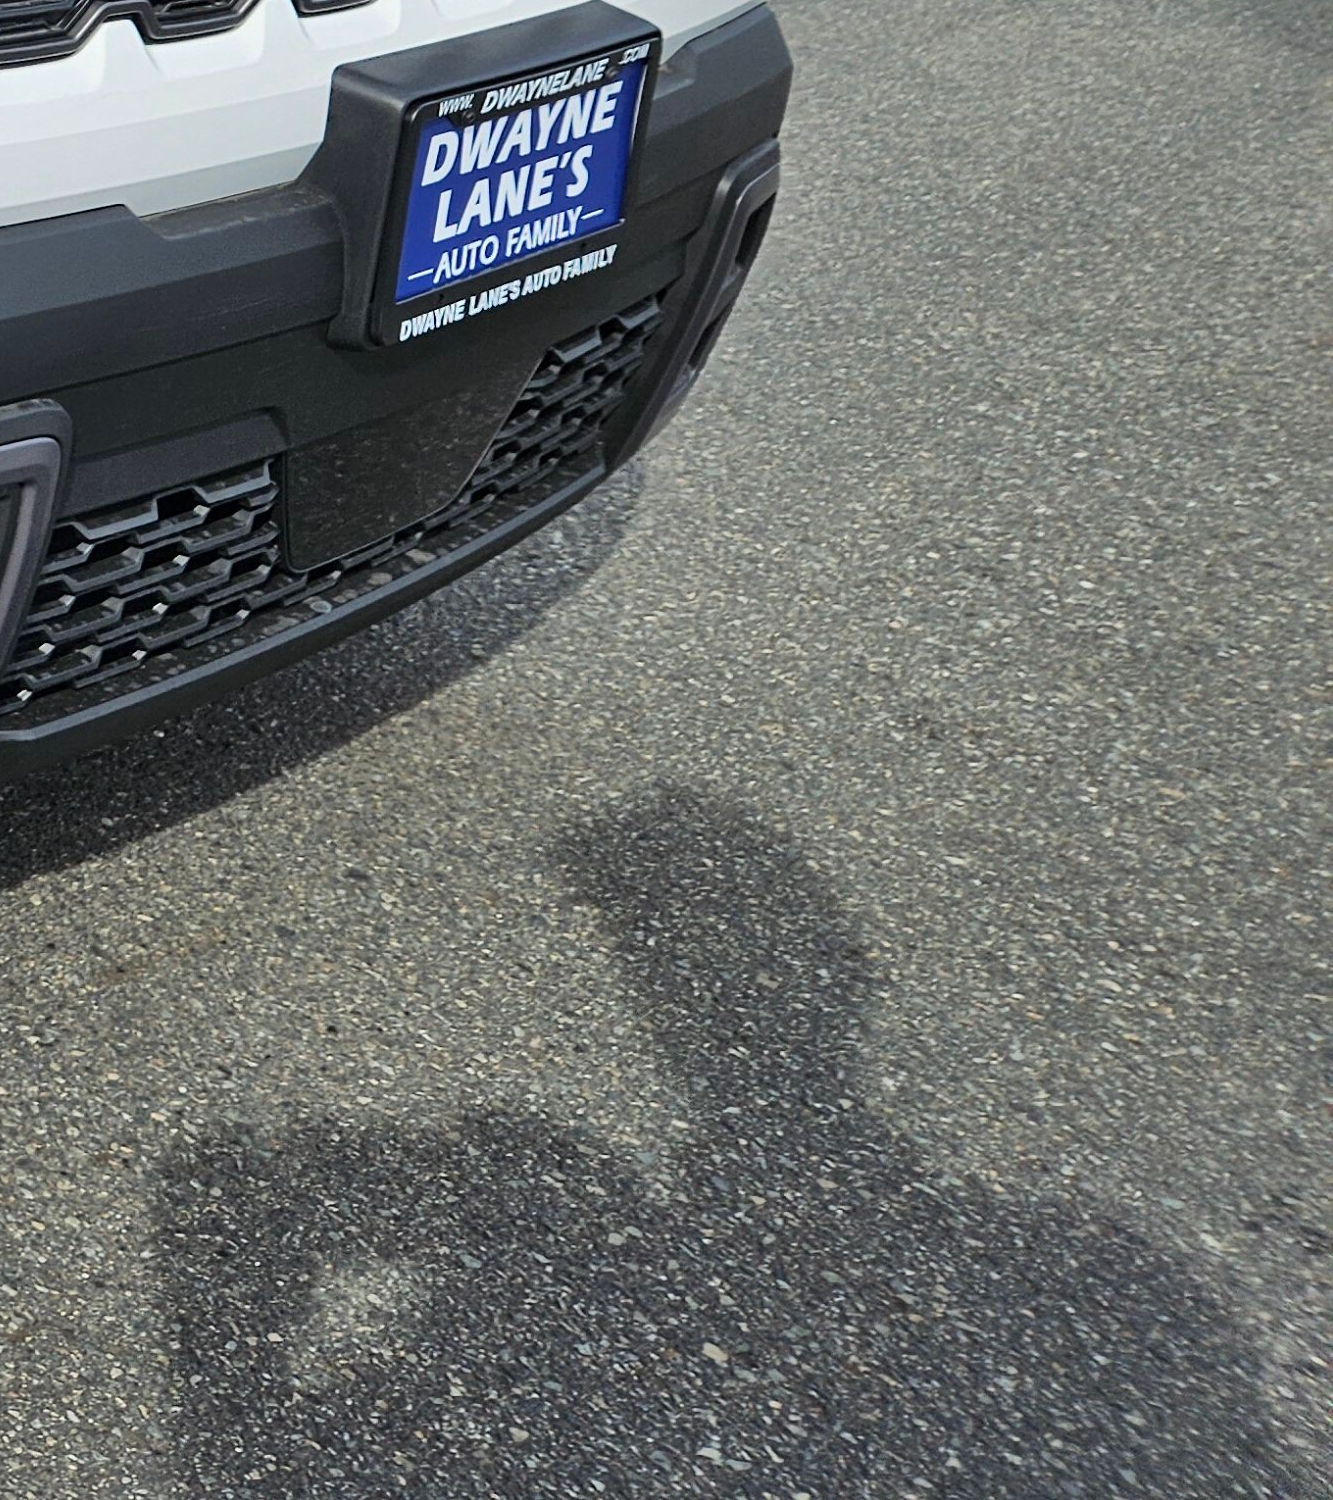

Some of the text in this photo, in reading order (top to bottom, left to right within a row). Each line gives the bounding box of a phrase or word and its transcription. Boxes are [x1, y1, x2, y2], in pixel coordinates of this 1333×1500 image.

[421, 80, 624, 187] DWAYNE
[480, 58, 611, 114] DWAYNELANE
[433, 144, 593, 243] LANE'S
[399, 243, 619, 342] DWAYNE LANE'S AUTO FAMILY
[433, 206, 584, 284] AUTO FAMILY
